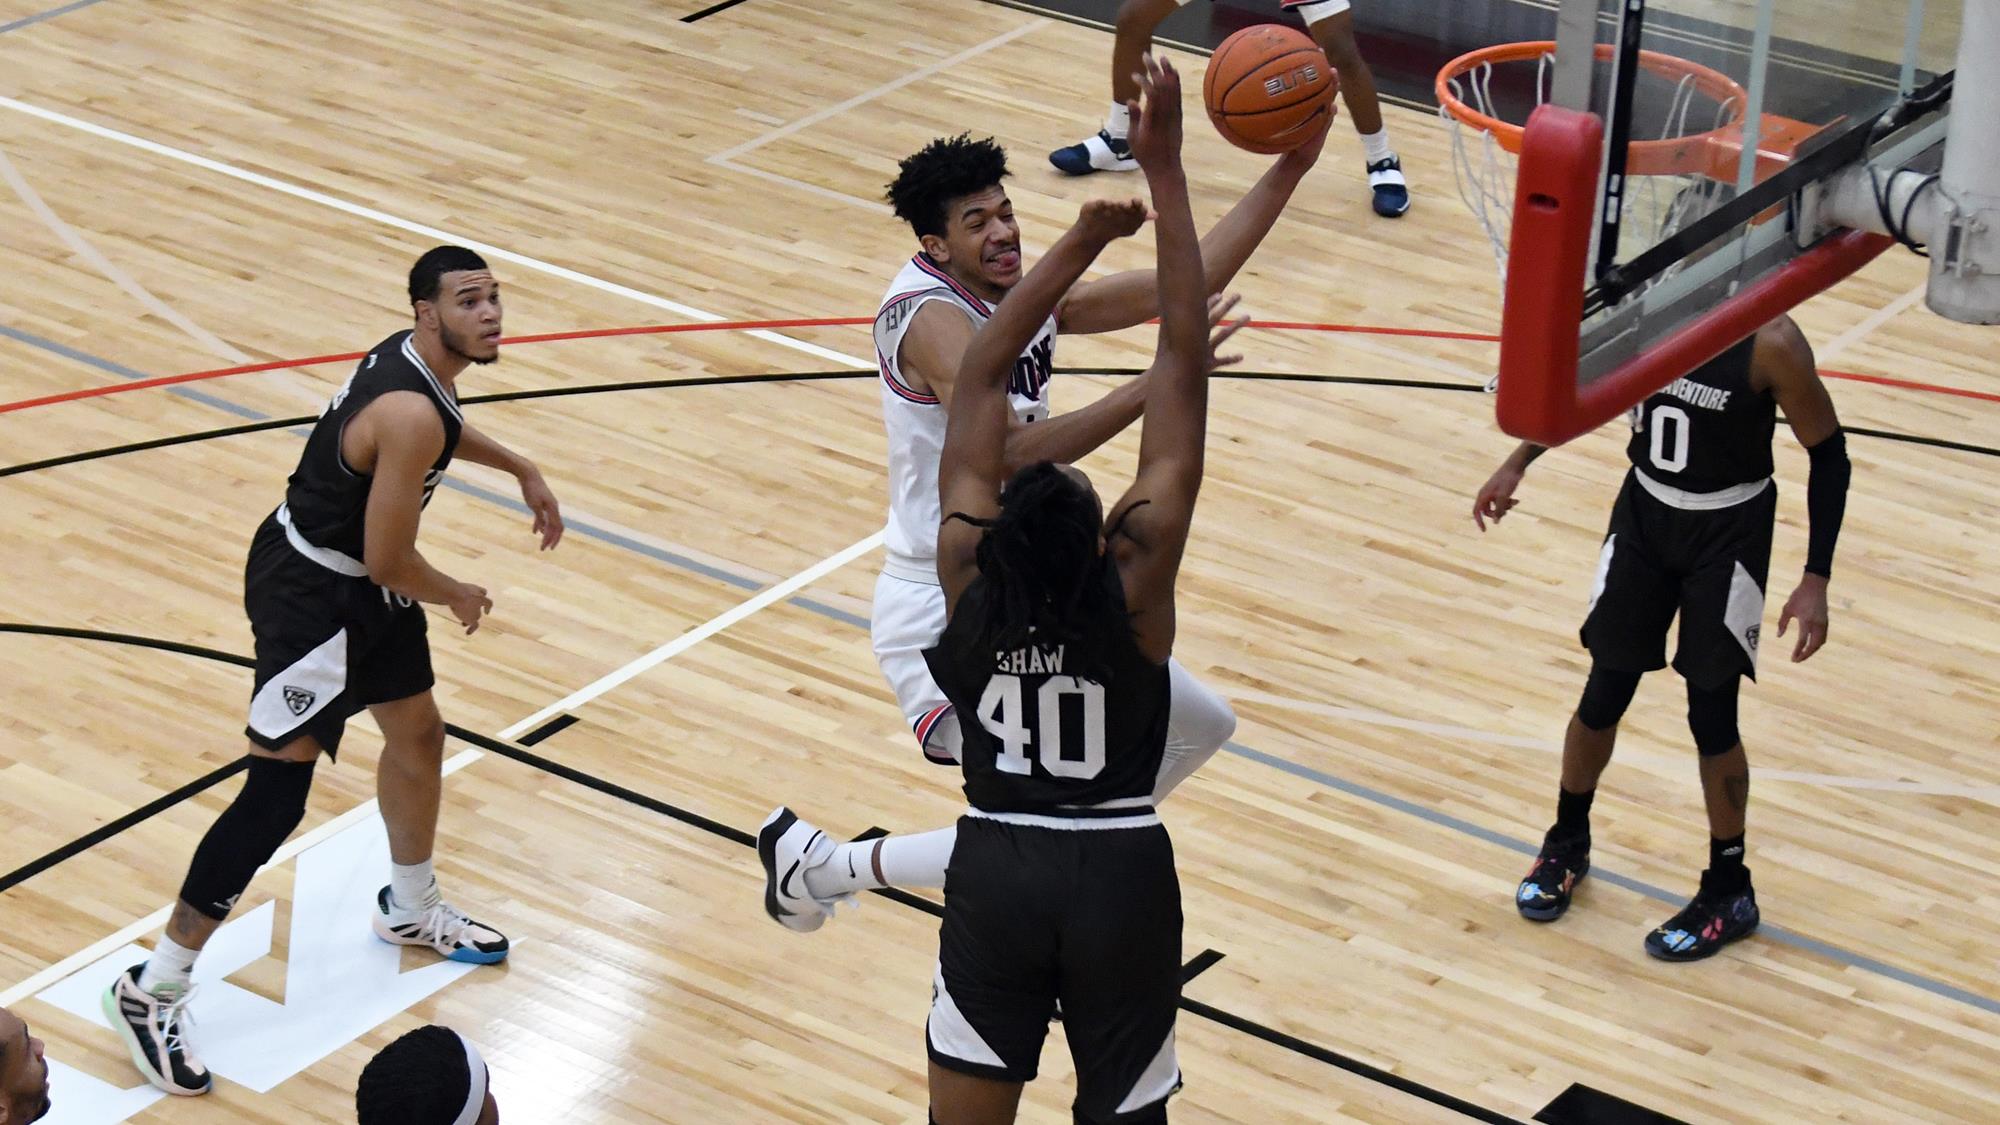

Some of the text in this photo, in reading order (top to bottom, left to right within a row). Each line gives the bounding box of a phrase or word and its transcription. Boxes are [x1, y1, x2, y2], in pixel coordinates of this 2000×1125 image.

[1661, 377, 1732, 411] AVENTURE
[996, 644, 1065, 674] SHAW
[976, 674, 1106, 780] 40
